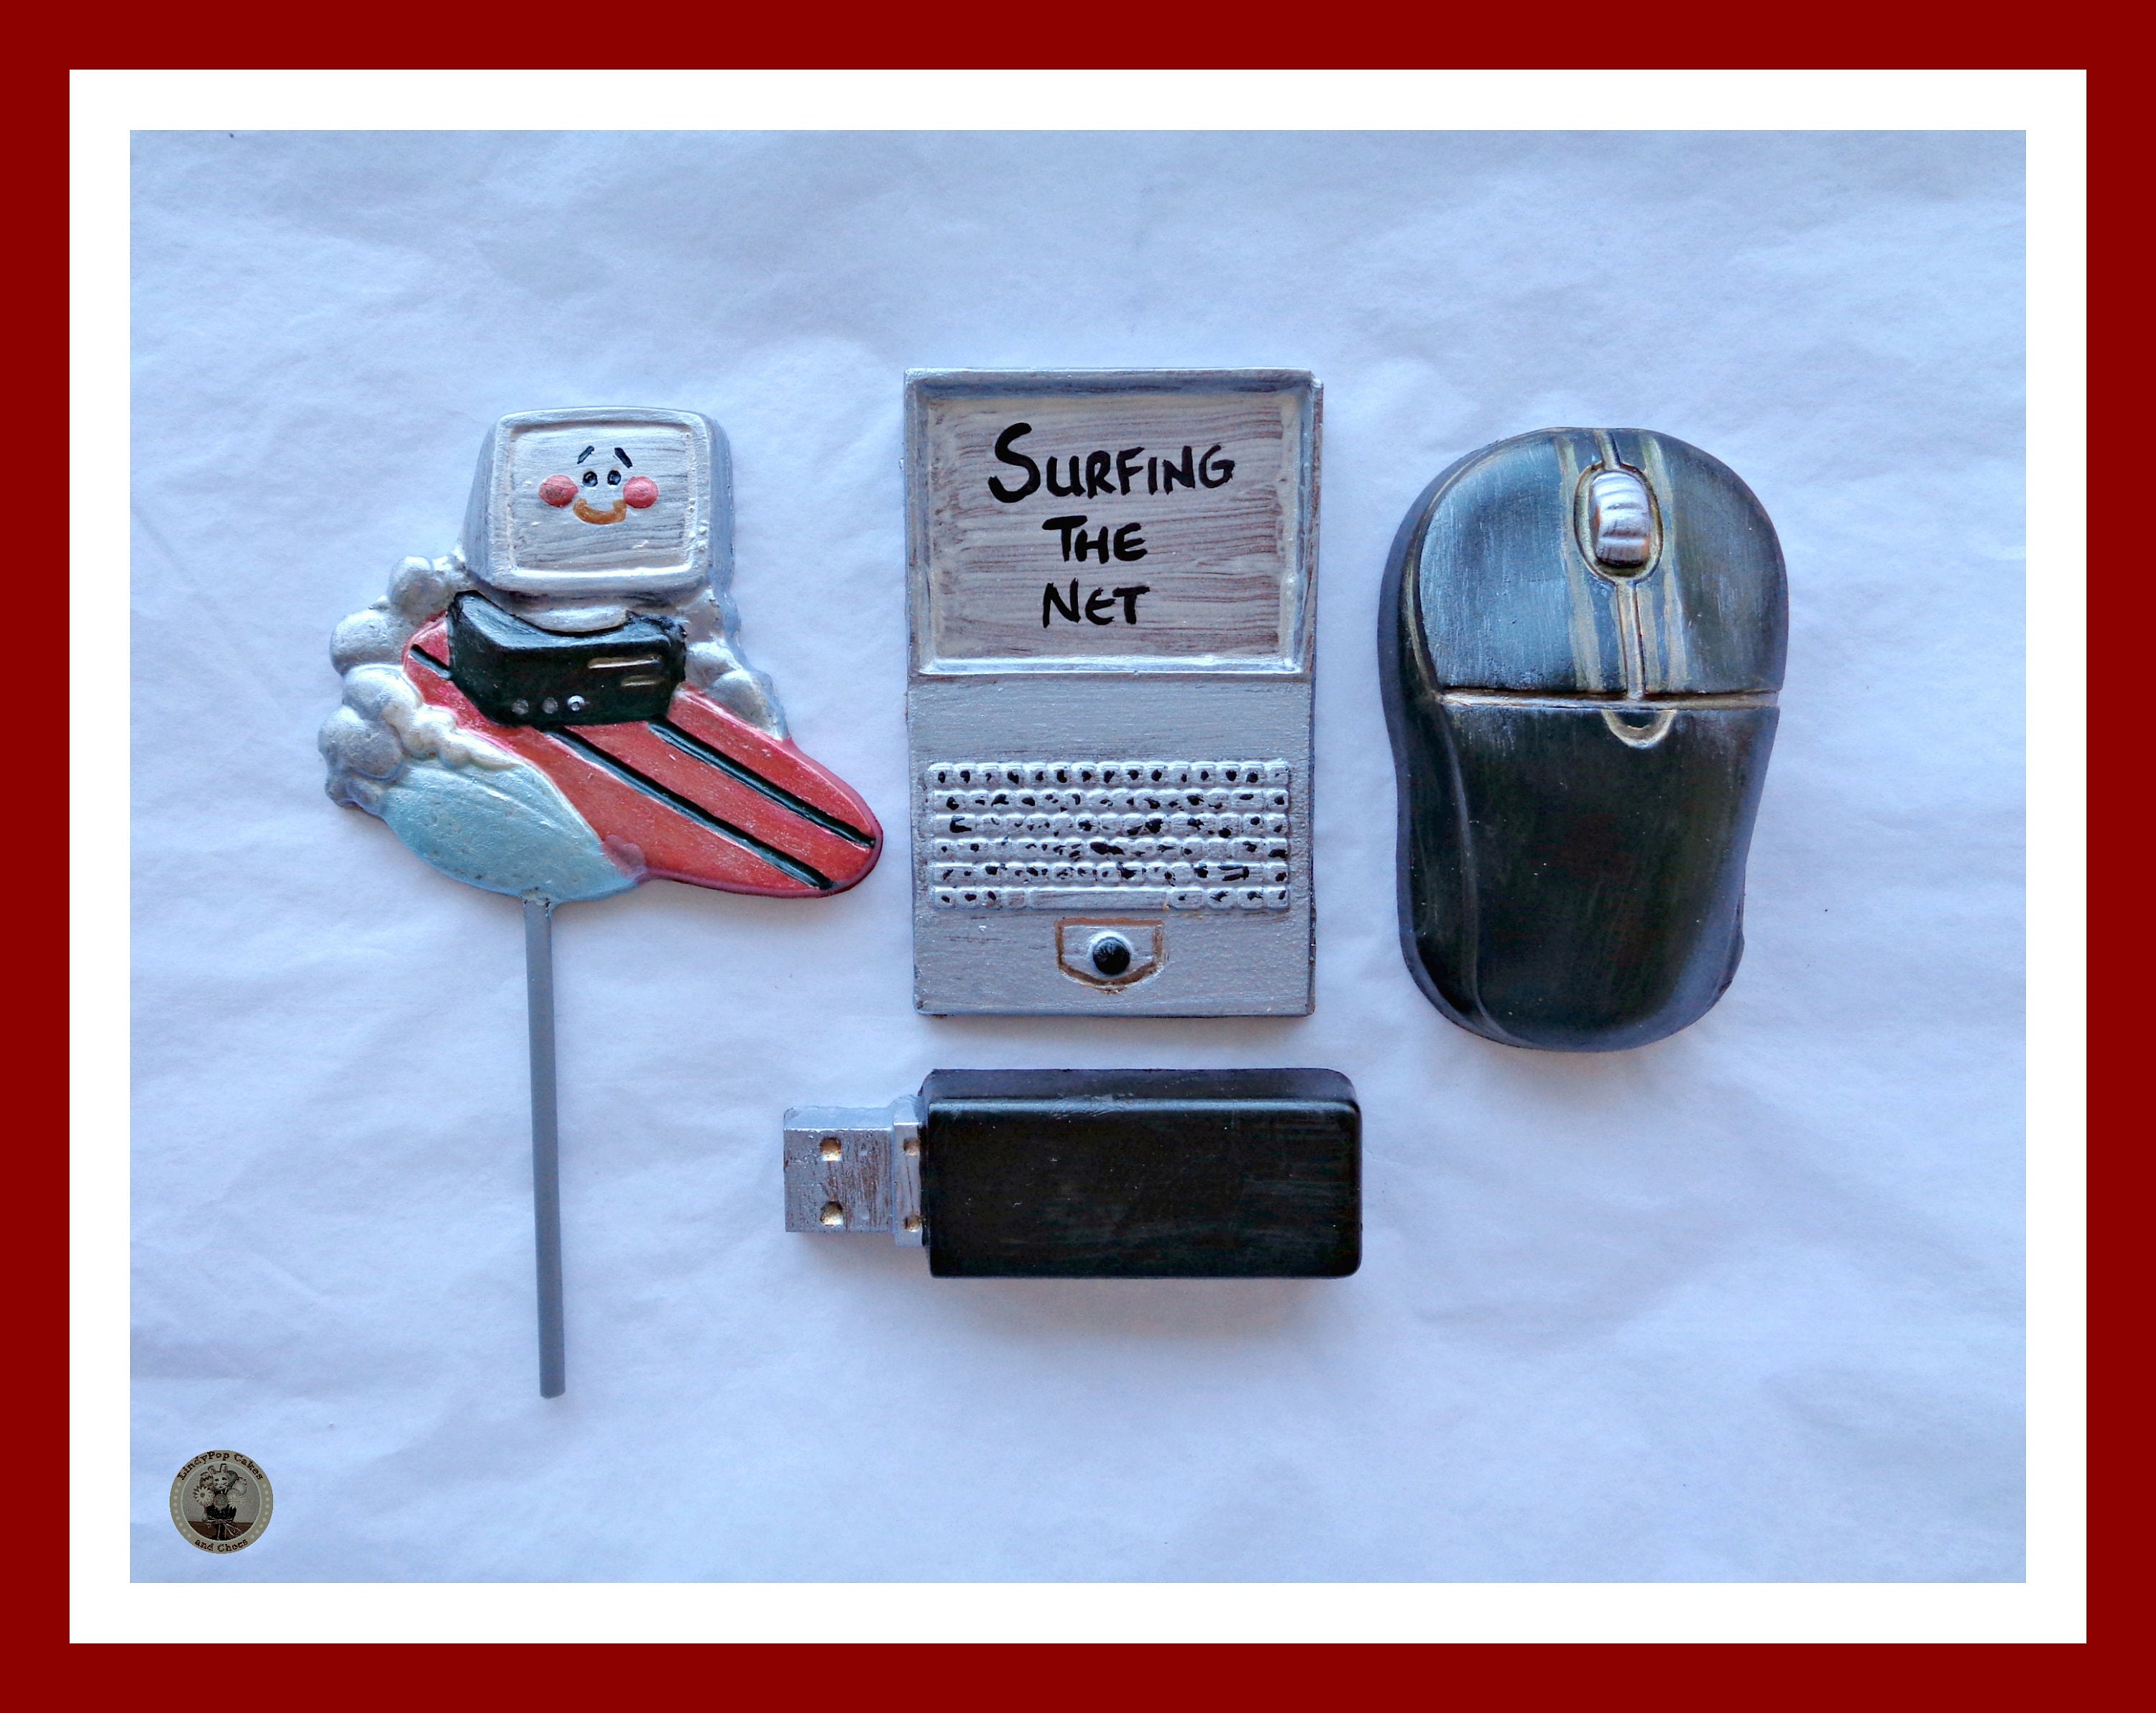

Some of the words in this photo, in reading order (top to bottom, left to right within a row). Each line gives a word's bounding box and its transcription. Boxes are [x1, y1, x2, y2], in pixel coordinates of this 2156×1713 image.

[987, 422, 1236, 503] SURFING
[1042, 515, 1148, 564] THE
[1042, 578, 1151, 628] NET
